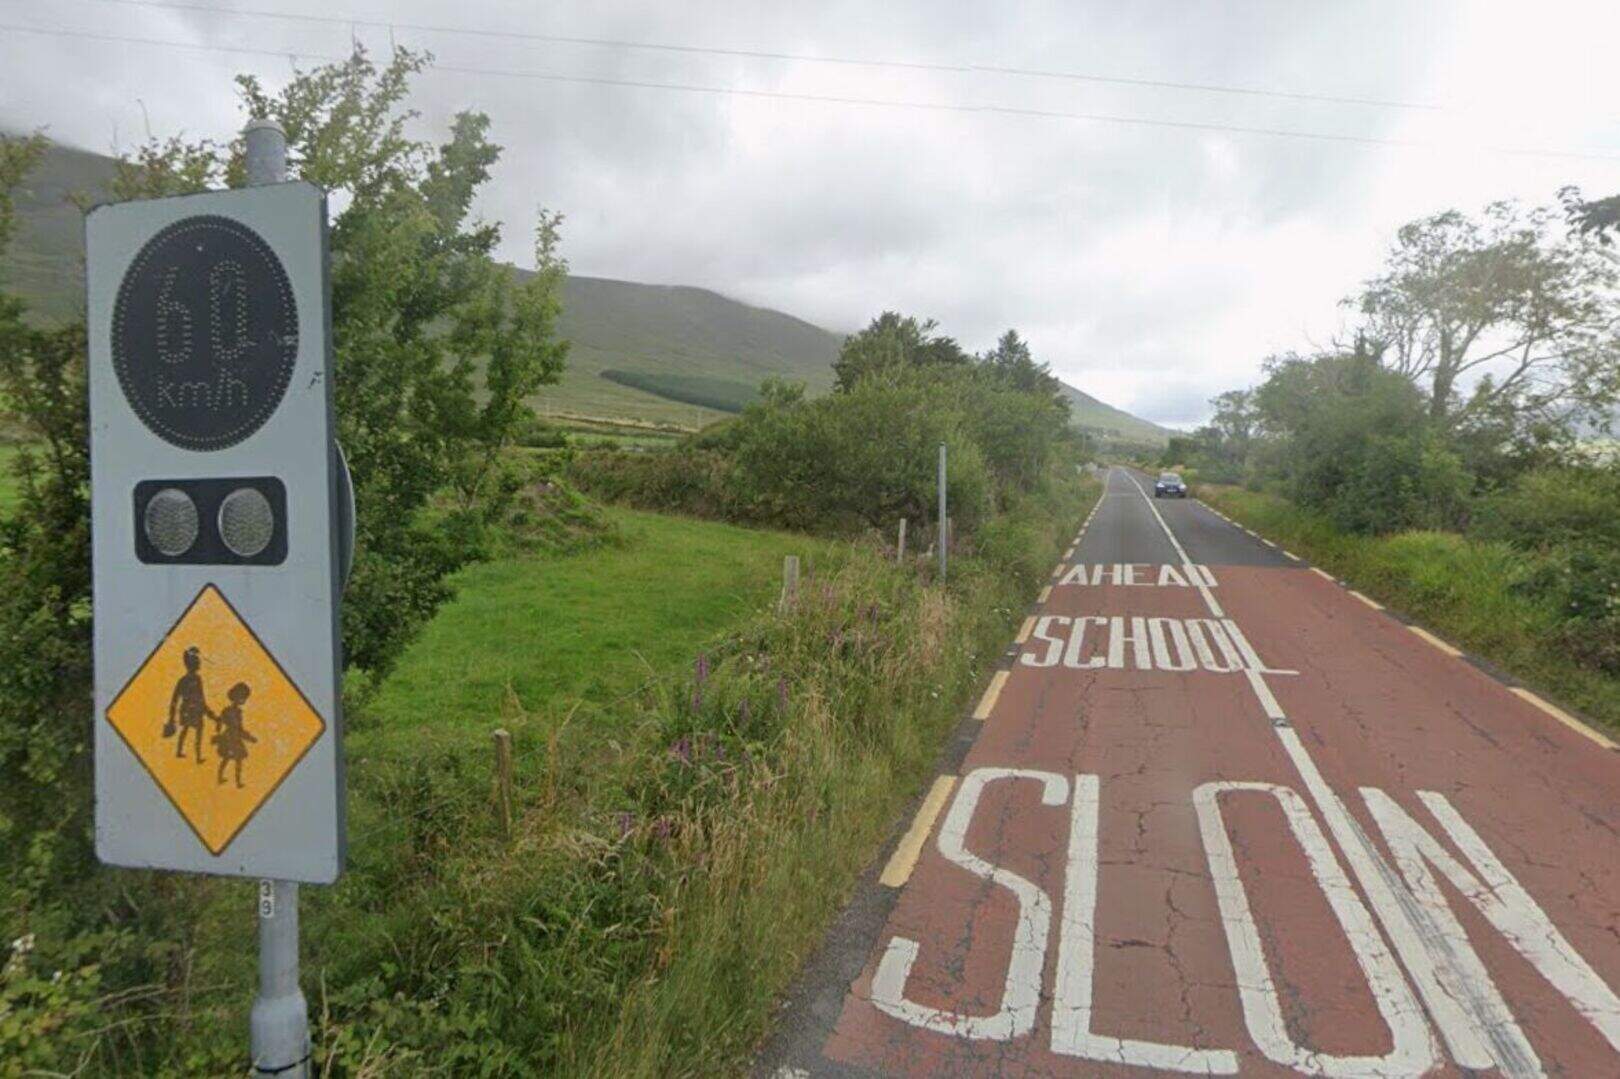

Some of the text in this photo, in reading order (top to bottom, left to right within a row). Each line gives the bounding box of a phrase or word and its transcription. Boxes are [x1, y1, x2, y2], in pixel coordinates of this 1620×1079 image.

[156, 259, 249, 364] 60
[157, 367, 248, 411] km/h
[1058, 563, 1219, 587] AHEAD
[1020, 615, 1300, 675] SCHOOL
[871, 767, 1620, 1079] SLOW
